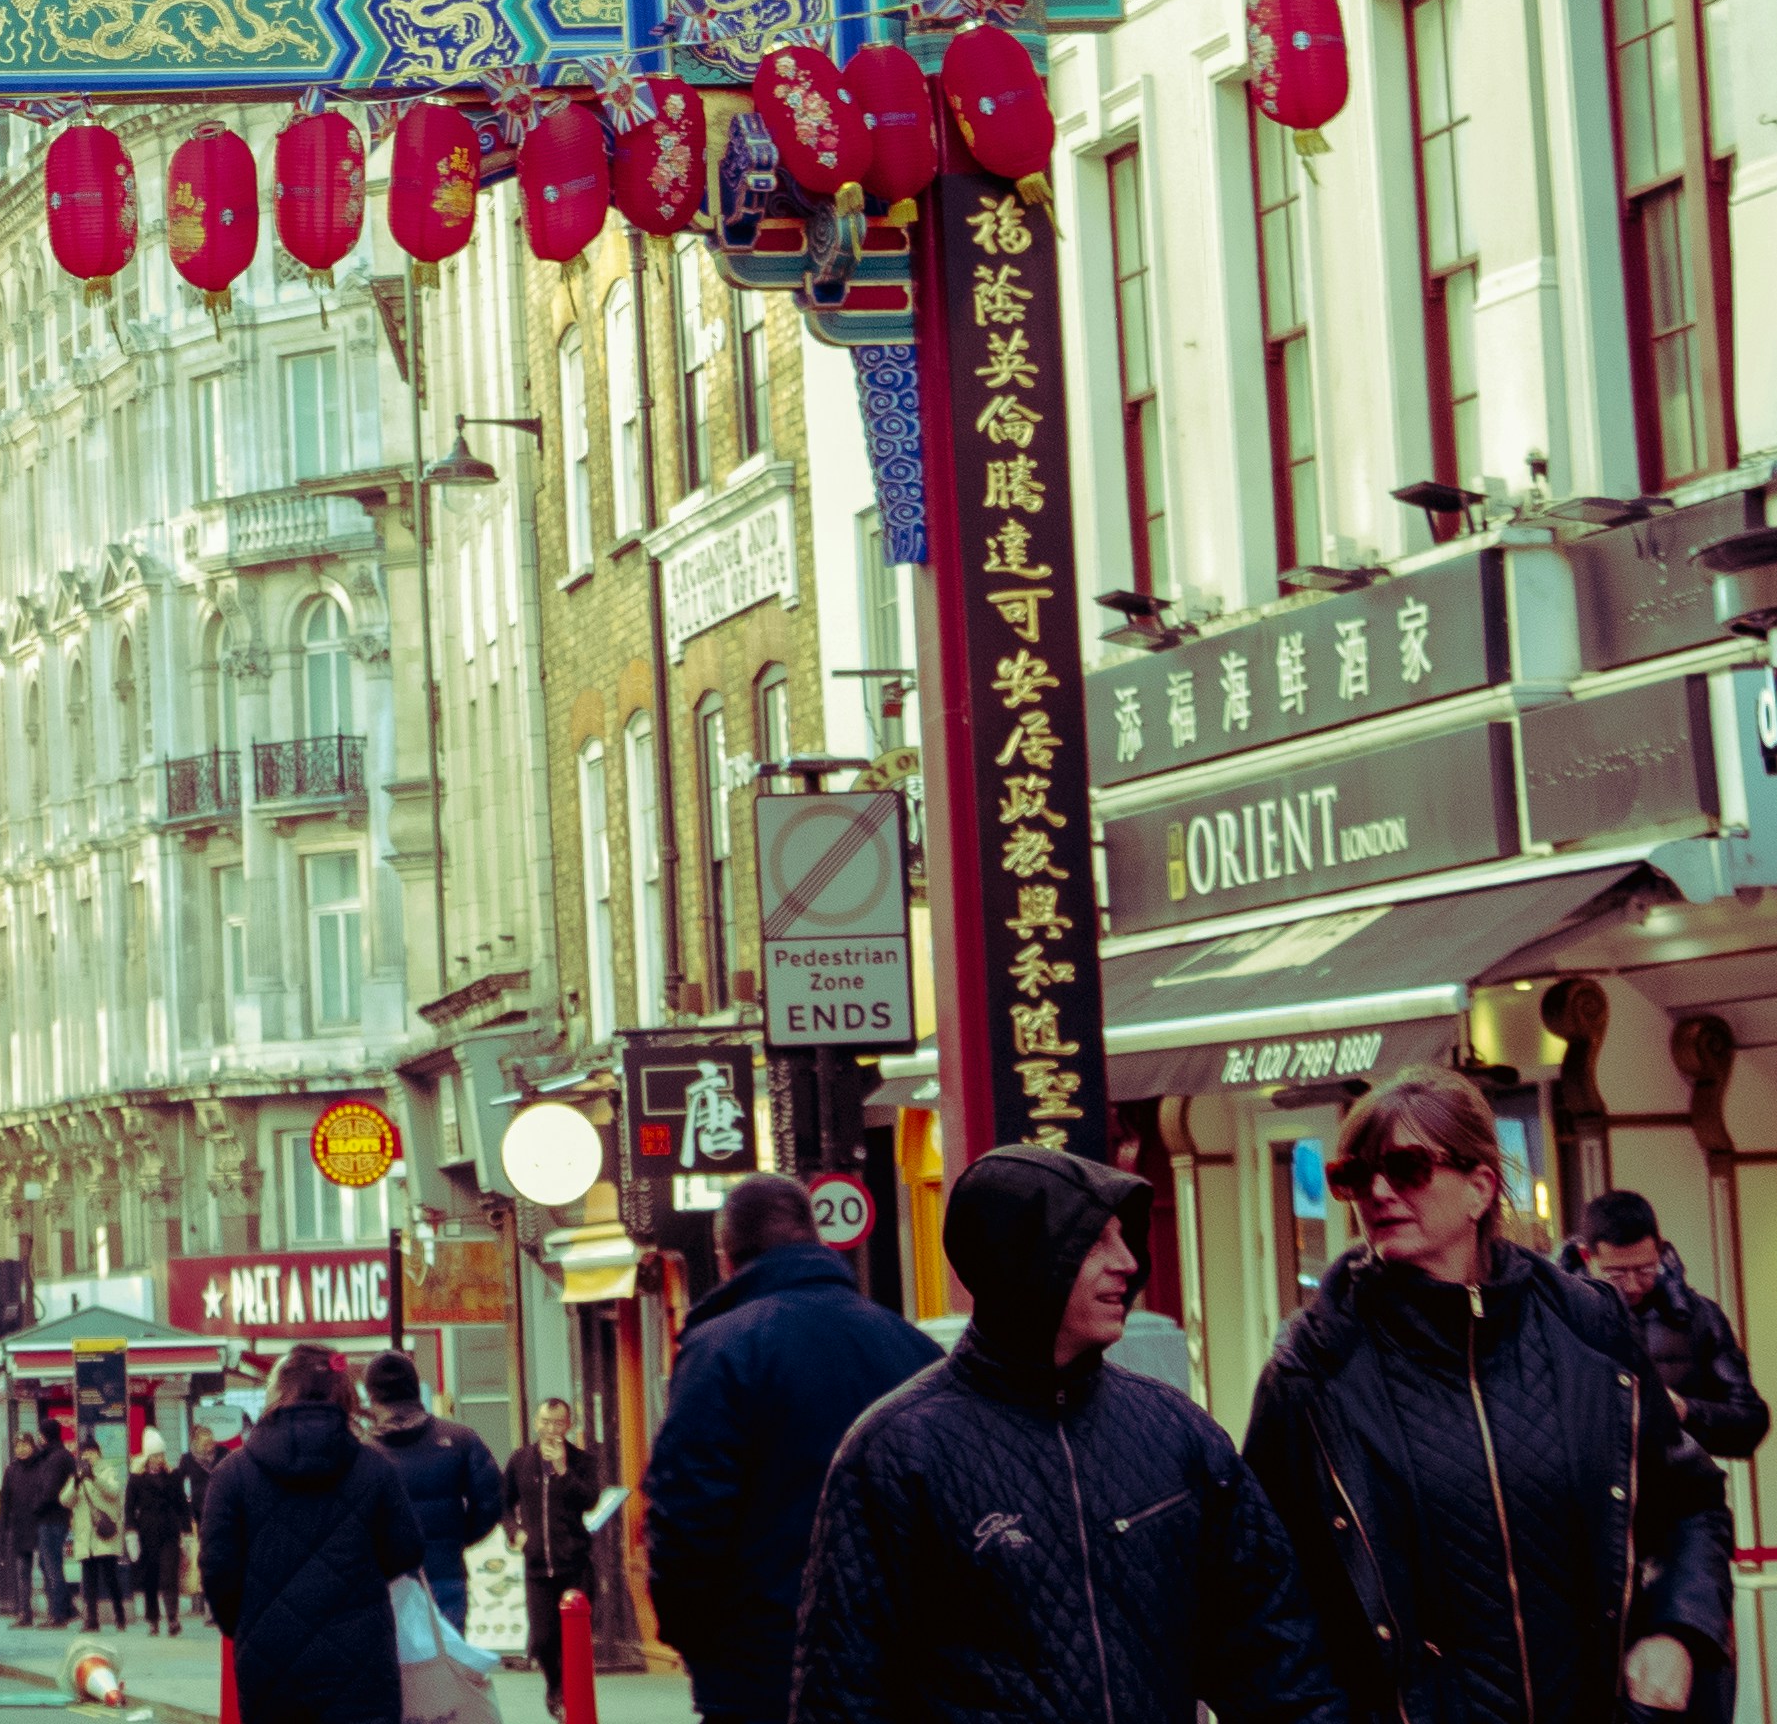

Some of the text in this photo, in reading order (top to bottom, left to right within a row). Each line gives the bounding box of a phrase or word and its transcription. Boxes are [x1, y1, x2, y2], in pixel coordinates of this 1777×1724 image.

[1186, 784, 1410, 895] ORIENT LONDON
[775, 948, 898, 968] Pedestrian
[810, 972, 865, 992] Zone
[787, 1002, 893, 1033] ENDS
[1221, 1046, 1255, 1083] Tel:
[1254, 1042, 1292, 1082] 020
[327, 1138, 381, 1154] SLOTS
[815, 1196, 863, 1226] 20
[230, 1264, 282, 1325] PRET
[287, 1266, 306, 1324] A
